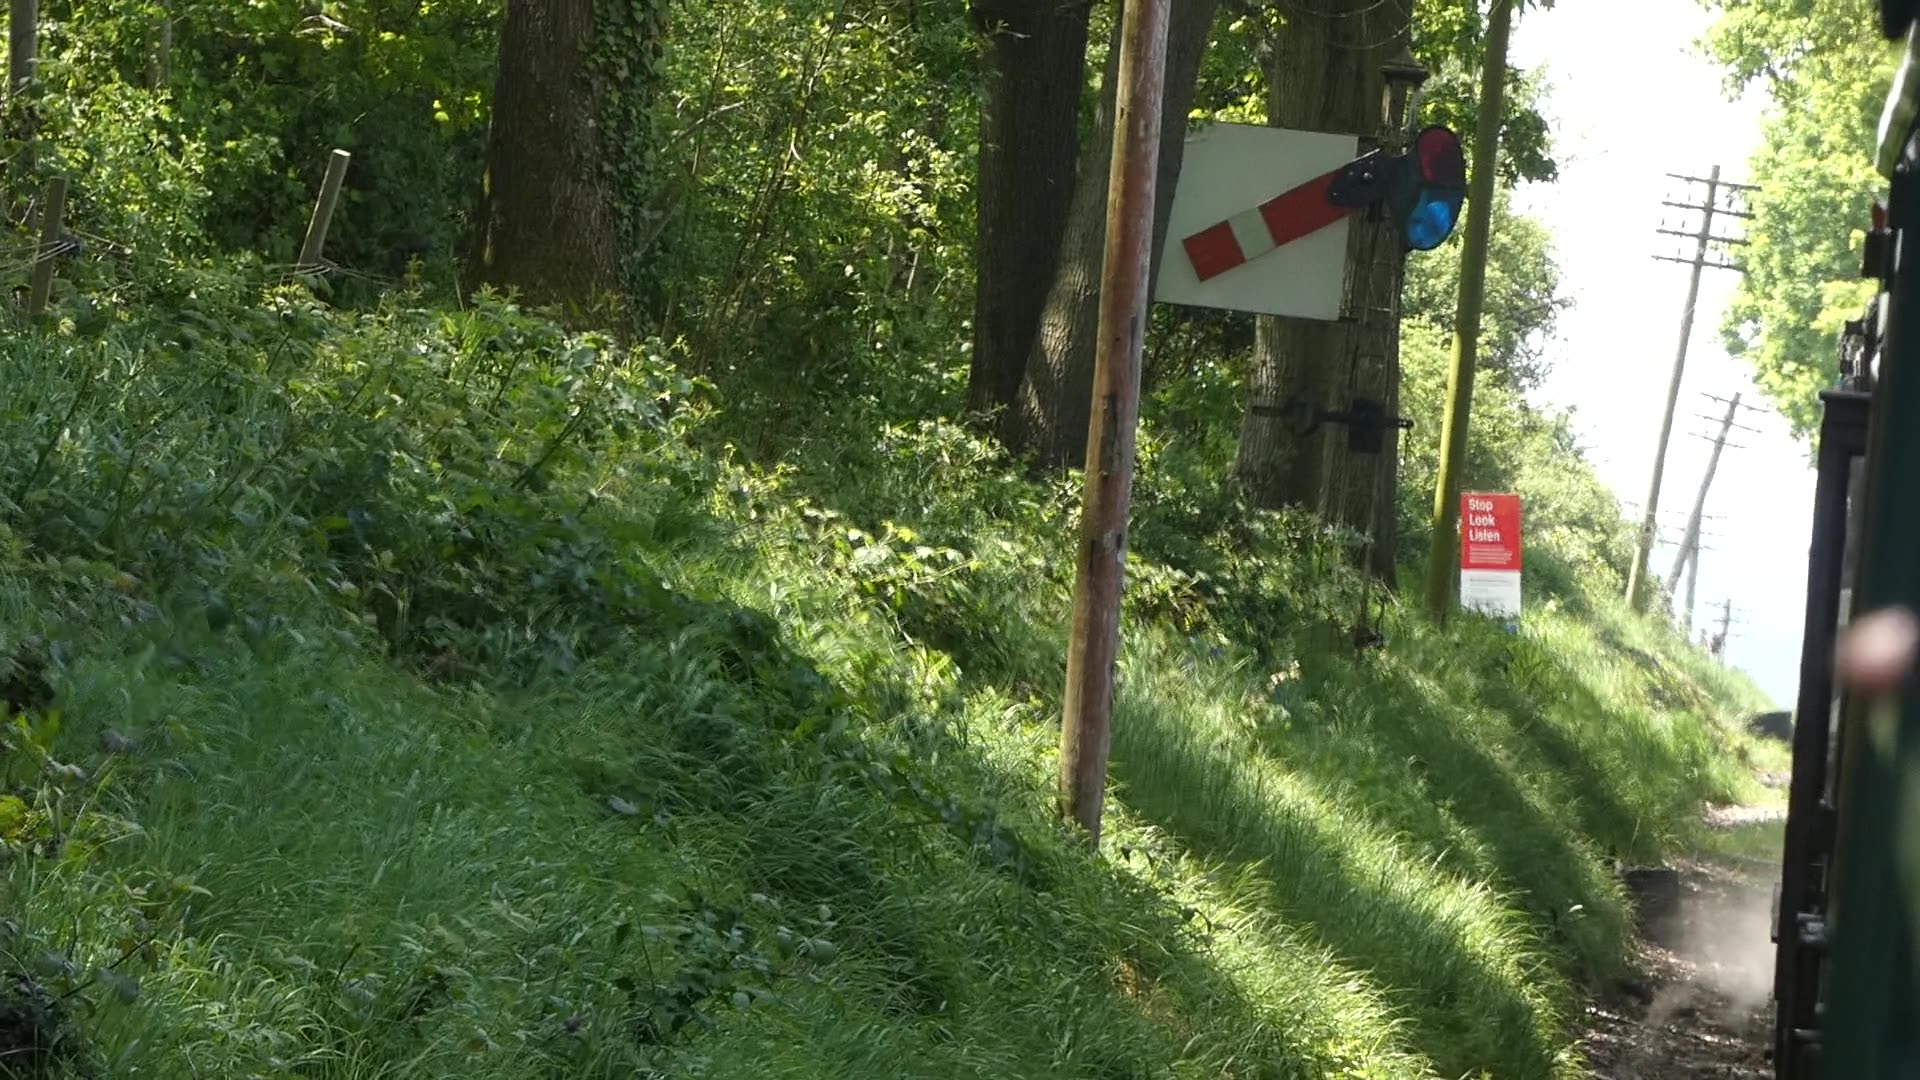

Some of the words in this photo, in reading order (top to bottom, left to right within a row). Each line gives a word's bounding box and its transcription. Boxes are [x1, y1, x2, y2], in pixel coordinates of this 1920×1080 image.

[1468, 498, 1493, 512] Stop
[1469, 513, 1495, 527] Look
[1469, 528, 1500, 542] Listen
